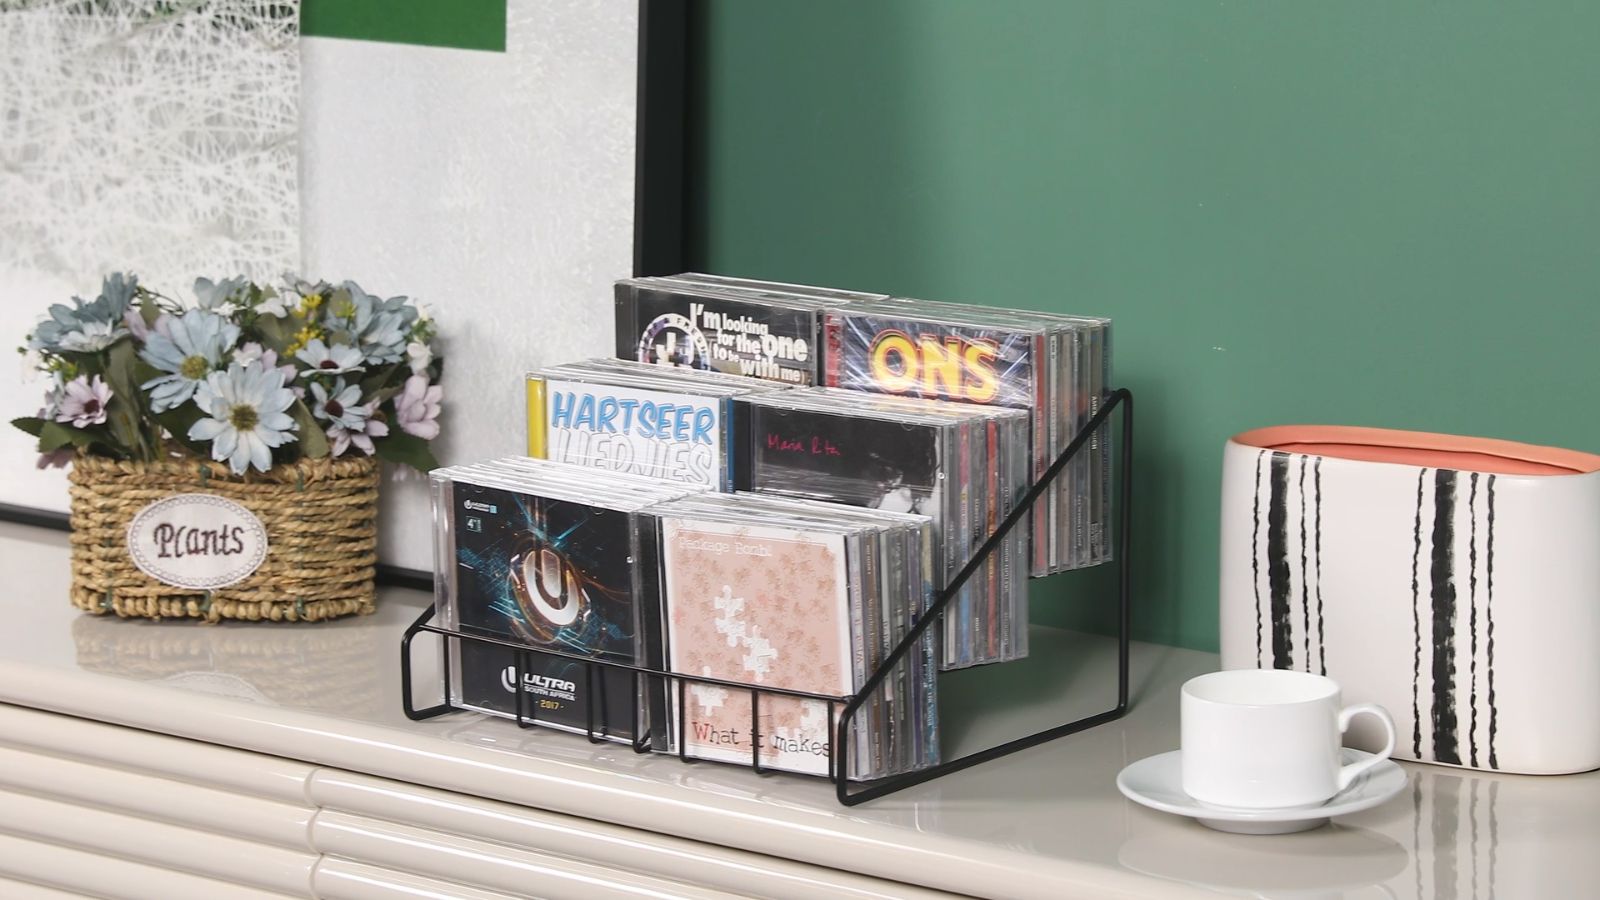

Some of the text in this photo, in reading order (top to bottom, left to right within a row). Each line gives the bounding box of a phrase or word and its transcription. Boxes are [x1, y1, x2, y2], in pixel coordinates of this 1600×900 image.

[690, 303, 769, 336] I'm looking
[717, 328, 808, 362] for the one
[740, 355, 780, 379] with
[868, 329, 998, 403] ONS
[552, 391, 715, 445] HARTSEER
[768, 433, 841, 456] Maria Rita
[153, 522, 244, 558] Plants
[678, 537, 730, 555] Package
[524, 673, 576, 692] ULTRA
[524, 686, 576, 702] SOUTH AFRICA
[540, 699, 560, 710] 2017
[692, 721, 739, 745] What
[774, 734, 830, 757] makes
